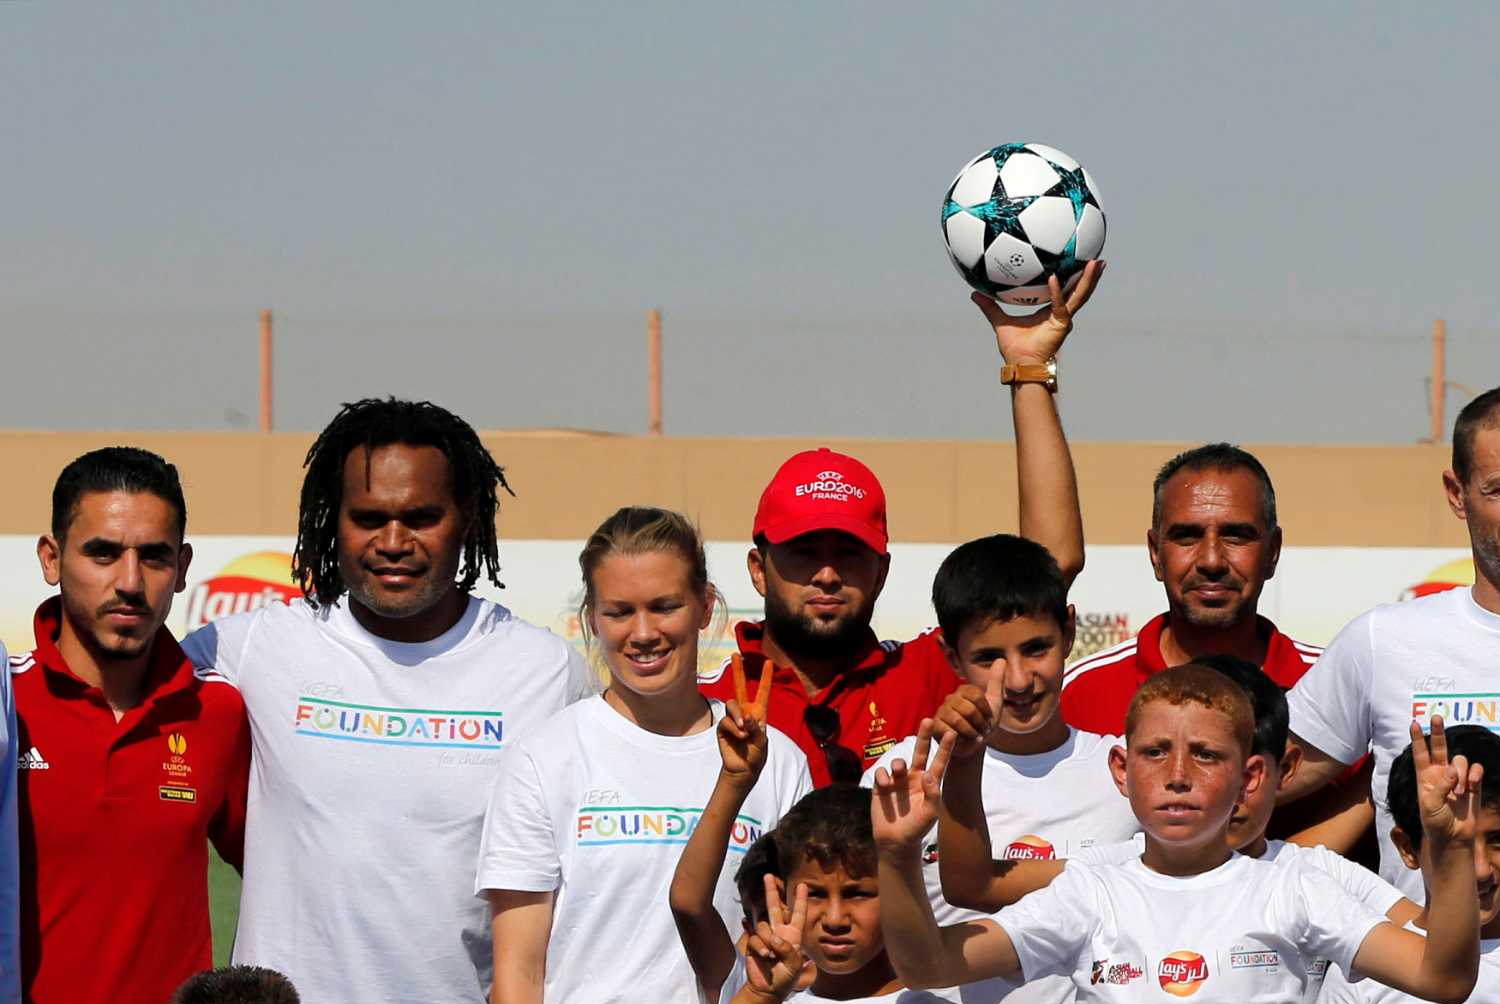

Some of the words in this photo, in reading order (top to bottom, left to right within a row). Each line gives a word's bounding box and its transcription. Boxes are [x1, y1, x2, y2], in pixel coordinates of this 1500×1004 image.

[812, 492, 848, 502] FRANCE
[296, 704, 503, 743] FOUNDATION
[162, 762, 192, 772] EUROPA
[1231, 953, 1278, 966] FOUNDATION
[1160, 960, 1188, 981] Lay's
